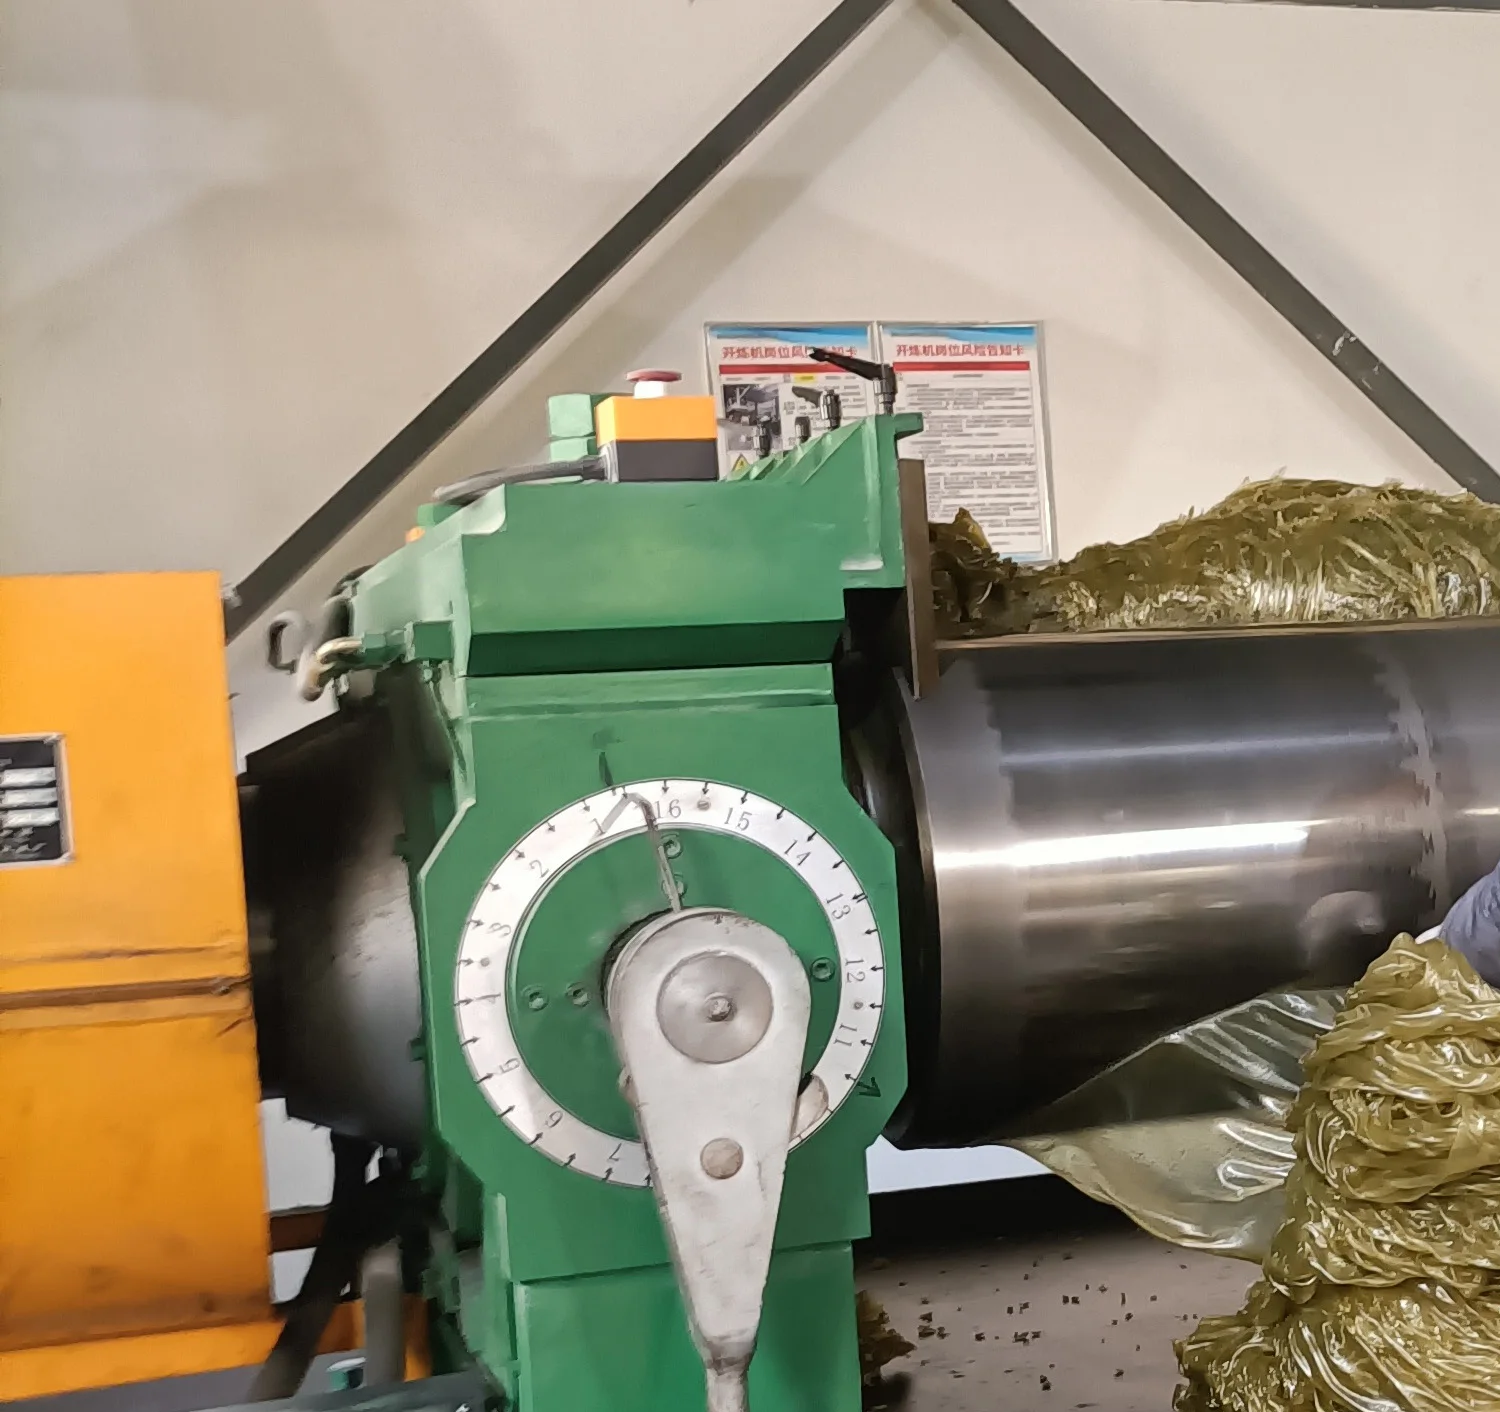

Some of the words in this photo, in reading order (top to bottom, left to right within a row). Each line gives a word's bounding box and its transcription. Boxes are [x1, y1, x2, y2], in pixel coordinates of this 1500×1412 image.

[655, 799, 682, 819] 16
[724, 807, 752, 831] 15
[784, 839, 812, 866] 14
[529, 859, 550, 879] 2
[826, 893, 851, 919] 13
[845, 958, 866, 983] 12
[833, 1023, 857, 1047] 11
[499, 1057, 521, 1074] 5
[607, 1143, 622, 1162] 7
